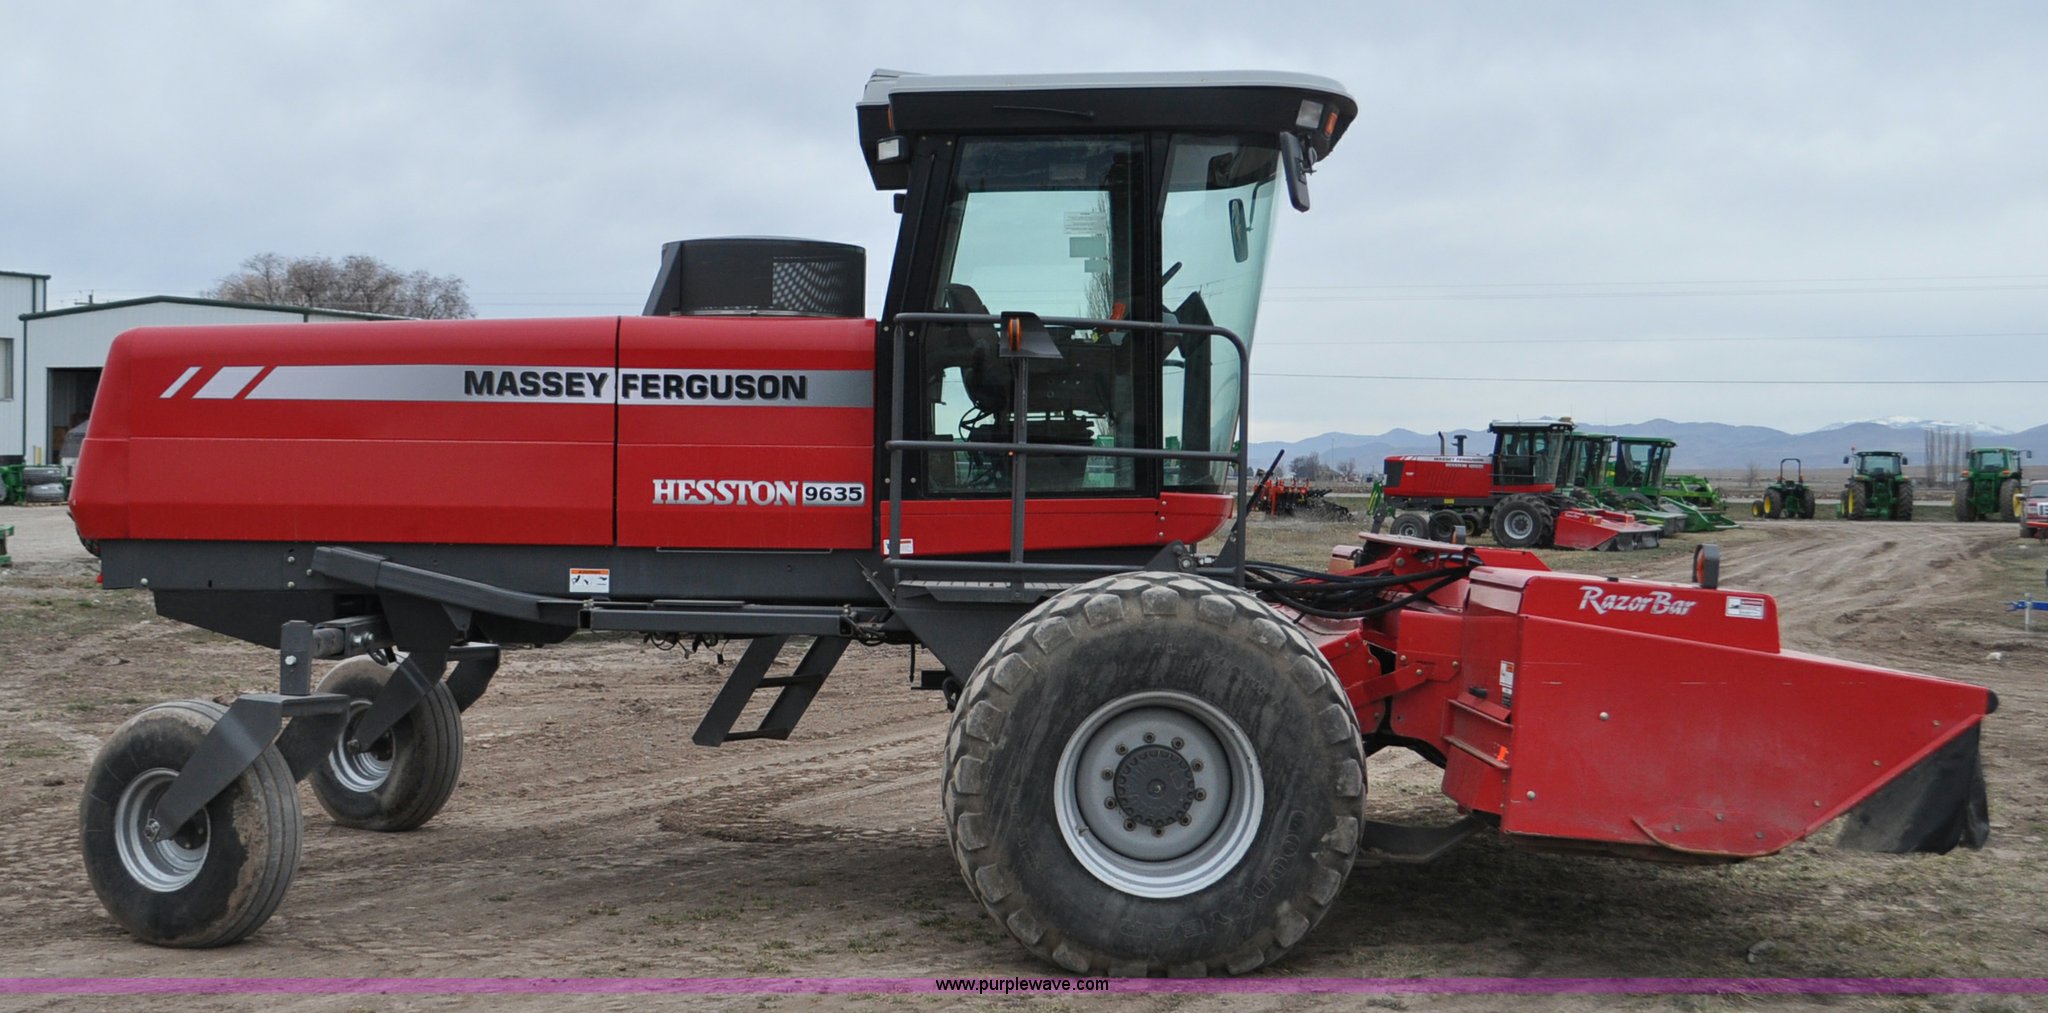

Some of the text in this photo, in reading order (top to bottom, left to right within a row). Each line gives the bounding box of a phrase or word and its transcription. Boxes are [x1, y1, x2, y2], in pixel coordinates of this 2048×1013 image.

[464, 370, 808, 401] MASSEY FERGUSON
[652, 479, 863, 506] HESSTON 9635
